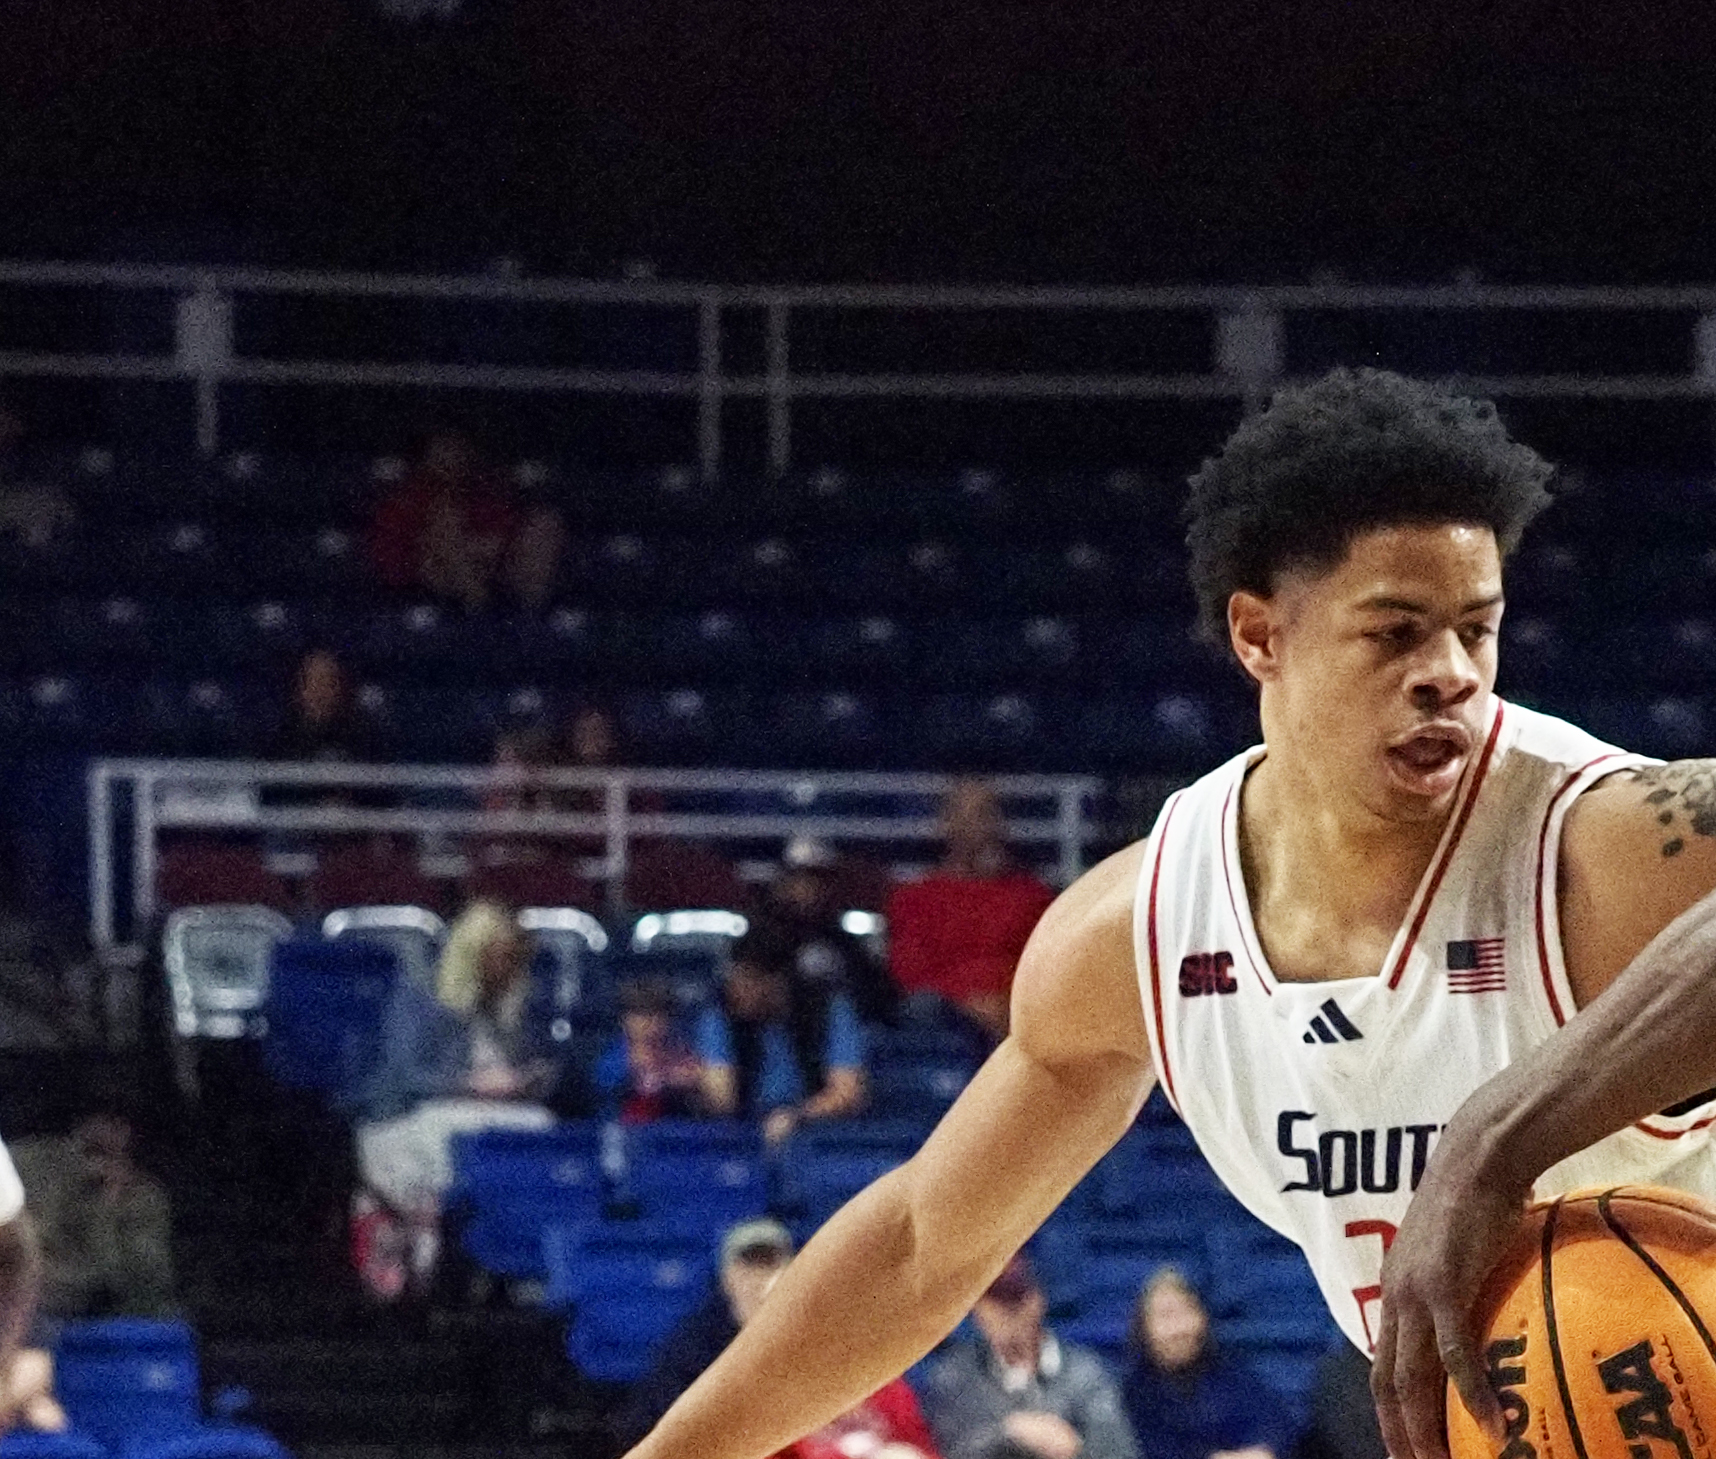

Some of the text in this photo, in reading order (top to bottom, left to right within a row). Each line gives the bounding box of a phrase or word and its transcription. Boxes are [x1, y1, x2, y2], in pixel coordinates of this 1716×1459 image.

[1277, 1110, 1447, 1197] SOUT
[1661, 1333, 1684, 1385] BALL
[1679, 1388, 1706, 1447] GAME
